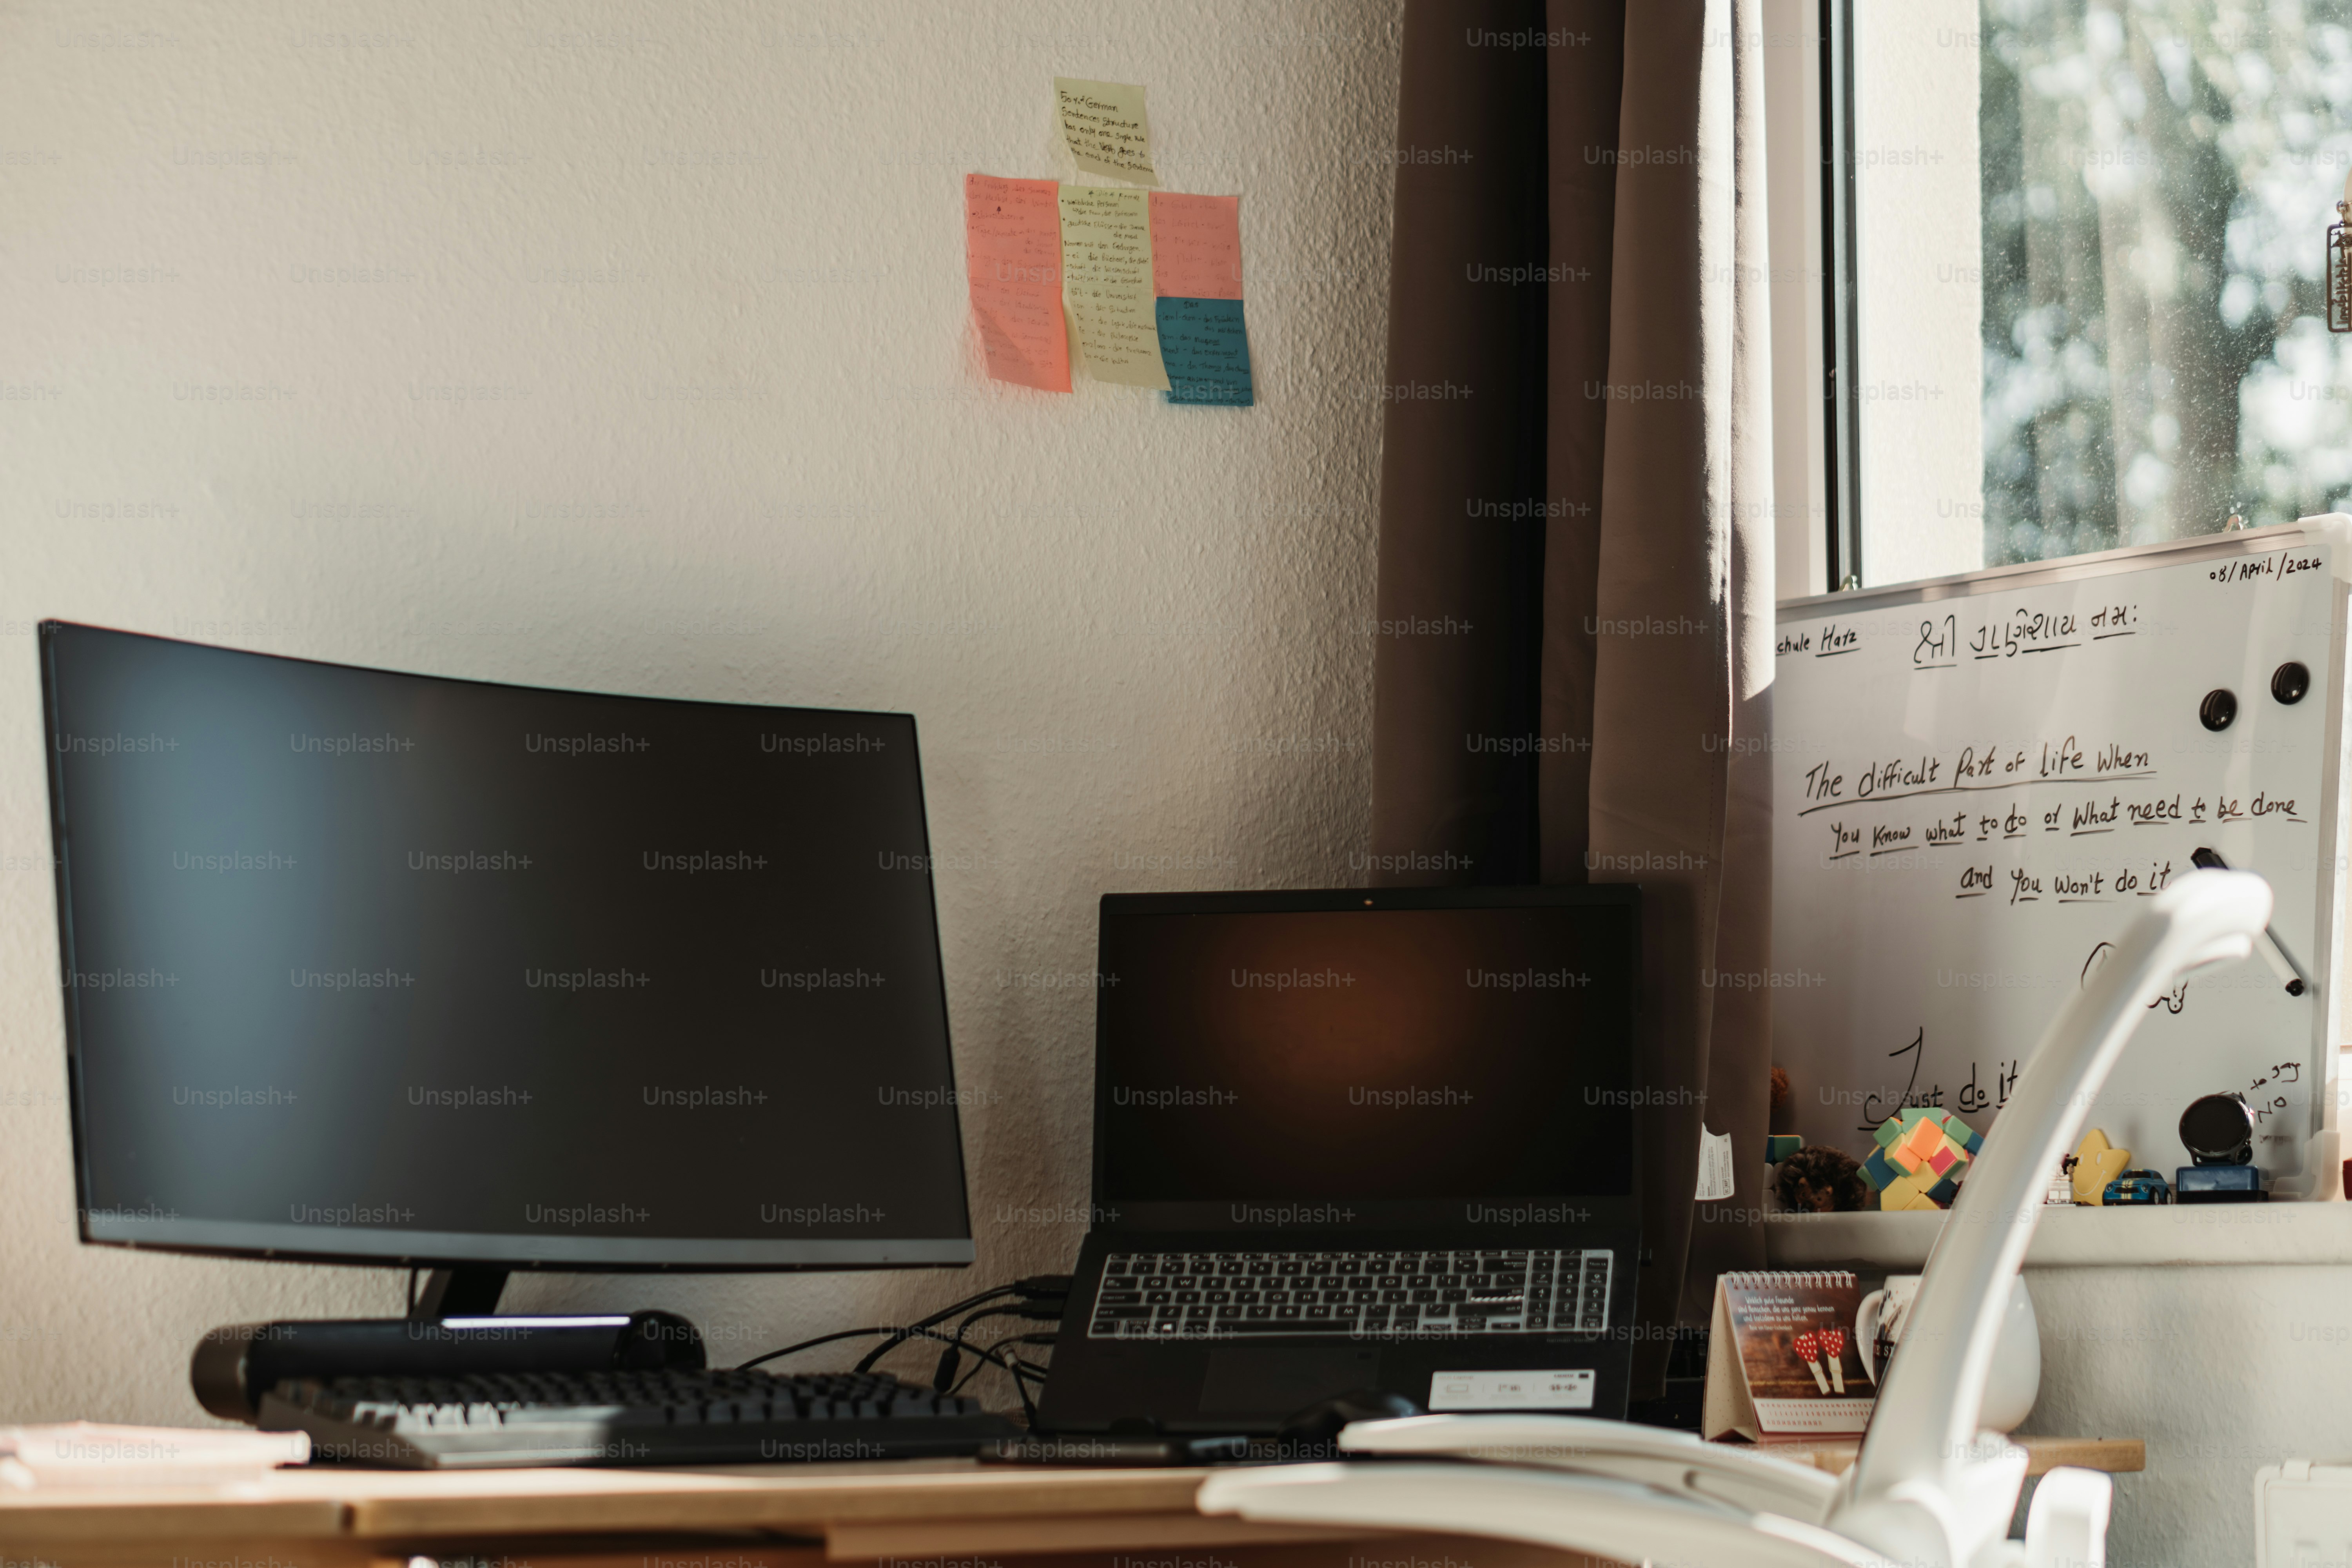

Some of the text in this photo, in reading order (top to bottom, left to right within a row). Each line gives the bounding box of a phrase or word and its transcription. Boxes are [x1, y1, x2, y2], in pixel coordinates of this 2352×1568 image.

[1086, 97, 1118, 112] German
[1065, 119, 1075, 131] has
[1080, 125, 1095, 138] only
[1066, 135, 1082, 146] that
[1084, 138, 1098, 150] the
[1085, 152, 1100, 161] end
[1113, 159, 1126, 169] the
[1088, 252, 1098, 261] die
[1092, 289, 1101, 297] die
[1187, 361, 1197, 369] das
[1821, 624, 1857, 651] Harz
[1805, 760, 1842, 800] The
[1858, 755, 1940, 797] difficult
[1926, 811, 1965, 841] what
[1980, 816, 1998, 836] to
[2004, 802, 2027, 833] do
[2127, 794, 2182, 820] need
[2192, 797, 2205, 820] to
[2218, 796, 2243, 818] be
[2251, 791, 2298, 816] done
[2115, 869, 2137, 892] do
[2150, 861, 2171, 890] it
[1864, 1026, 2018, 1125] Just do it
[1764, 1296, 1774, 1305] gute
[1775, 1295, 1794, 1304] Freunde
[1748, 1305, 1771, 1313] Menschen,
[1817, 1305, 1834, 1313] kennen
